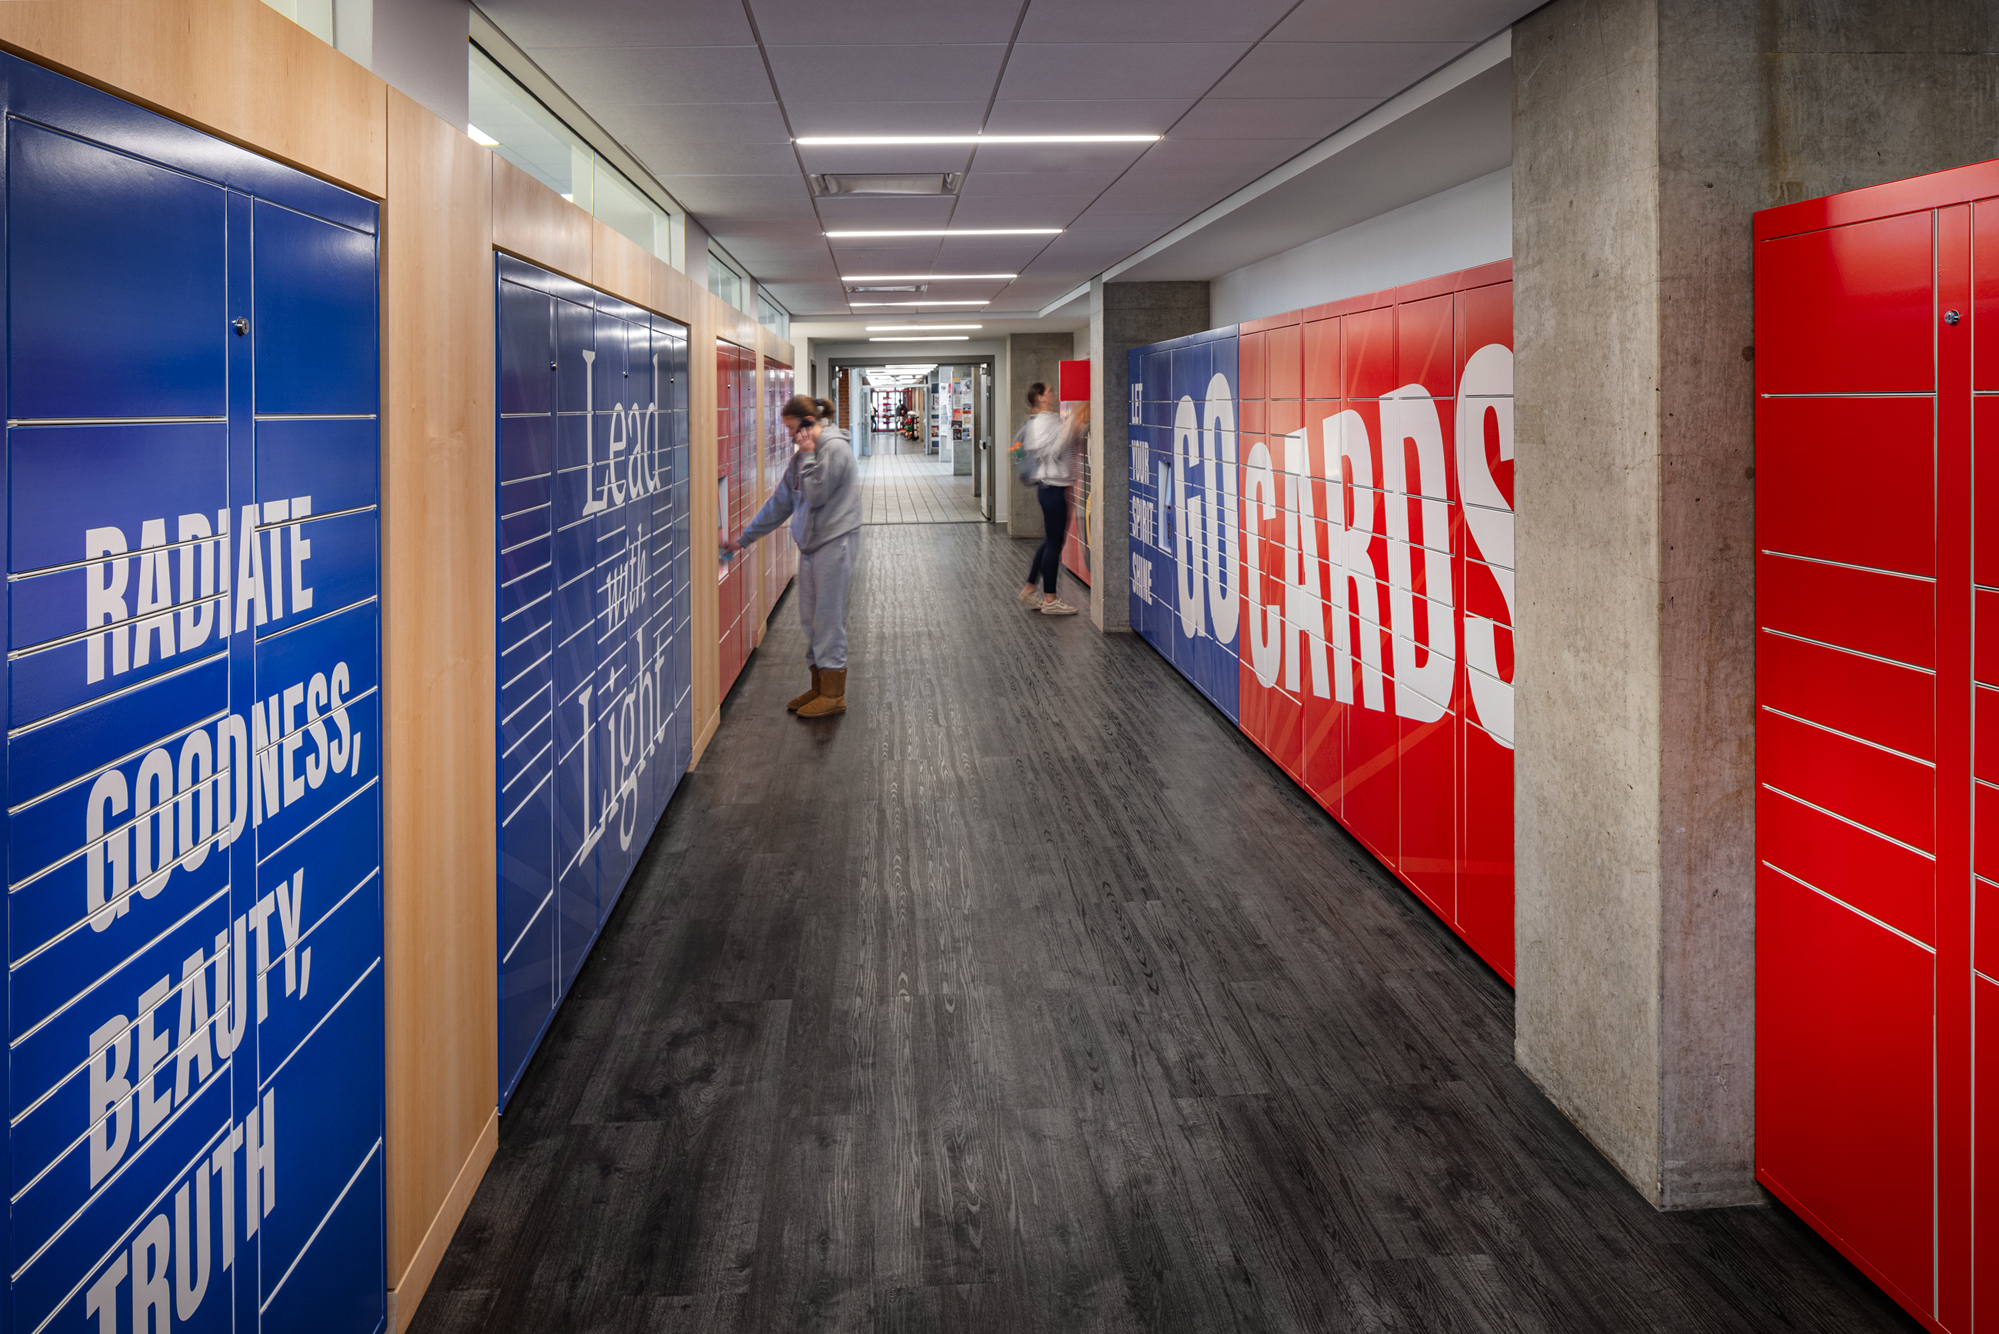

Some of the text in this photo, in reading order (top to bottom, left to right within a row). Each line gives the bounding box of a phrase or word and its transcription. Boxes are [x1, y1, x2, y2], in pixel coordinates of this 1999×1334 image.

[582, 350, 661, 516] Lead
[1131, 383, 1143, 424] LET
[1131, 440, 1150, 485] YOUR
[86, 496, 314, 685] RADIATE
[605, 523, 647, 631] with
[1131, 495, 1154, 546] SPIRIT
[1132, 551, 1153, 606] SHINE
[1174, 373, 1240, 644] GO
[86, 661, 362, 933] GOODNESS,
[578, 628, 666, 867] Light
[89, 868, 312, 1190] BEAUTY,
